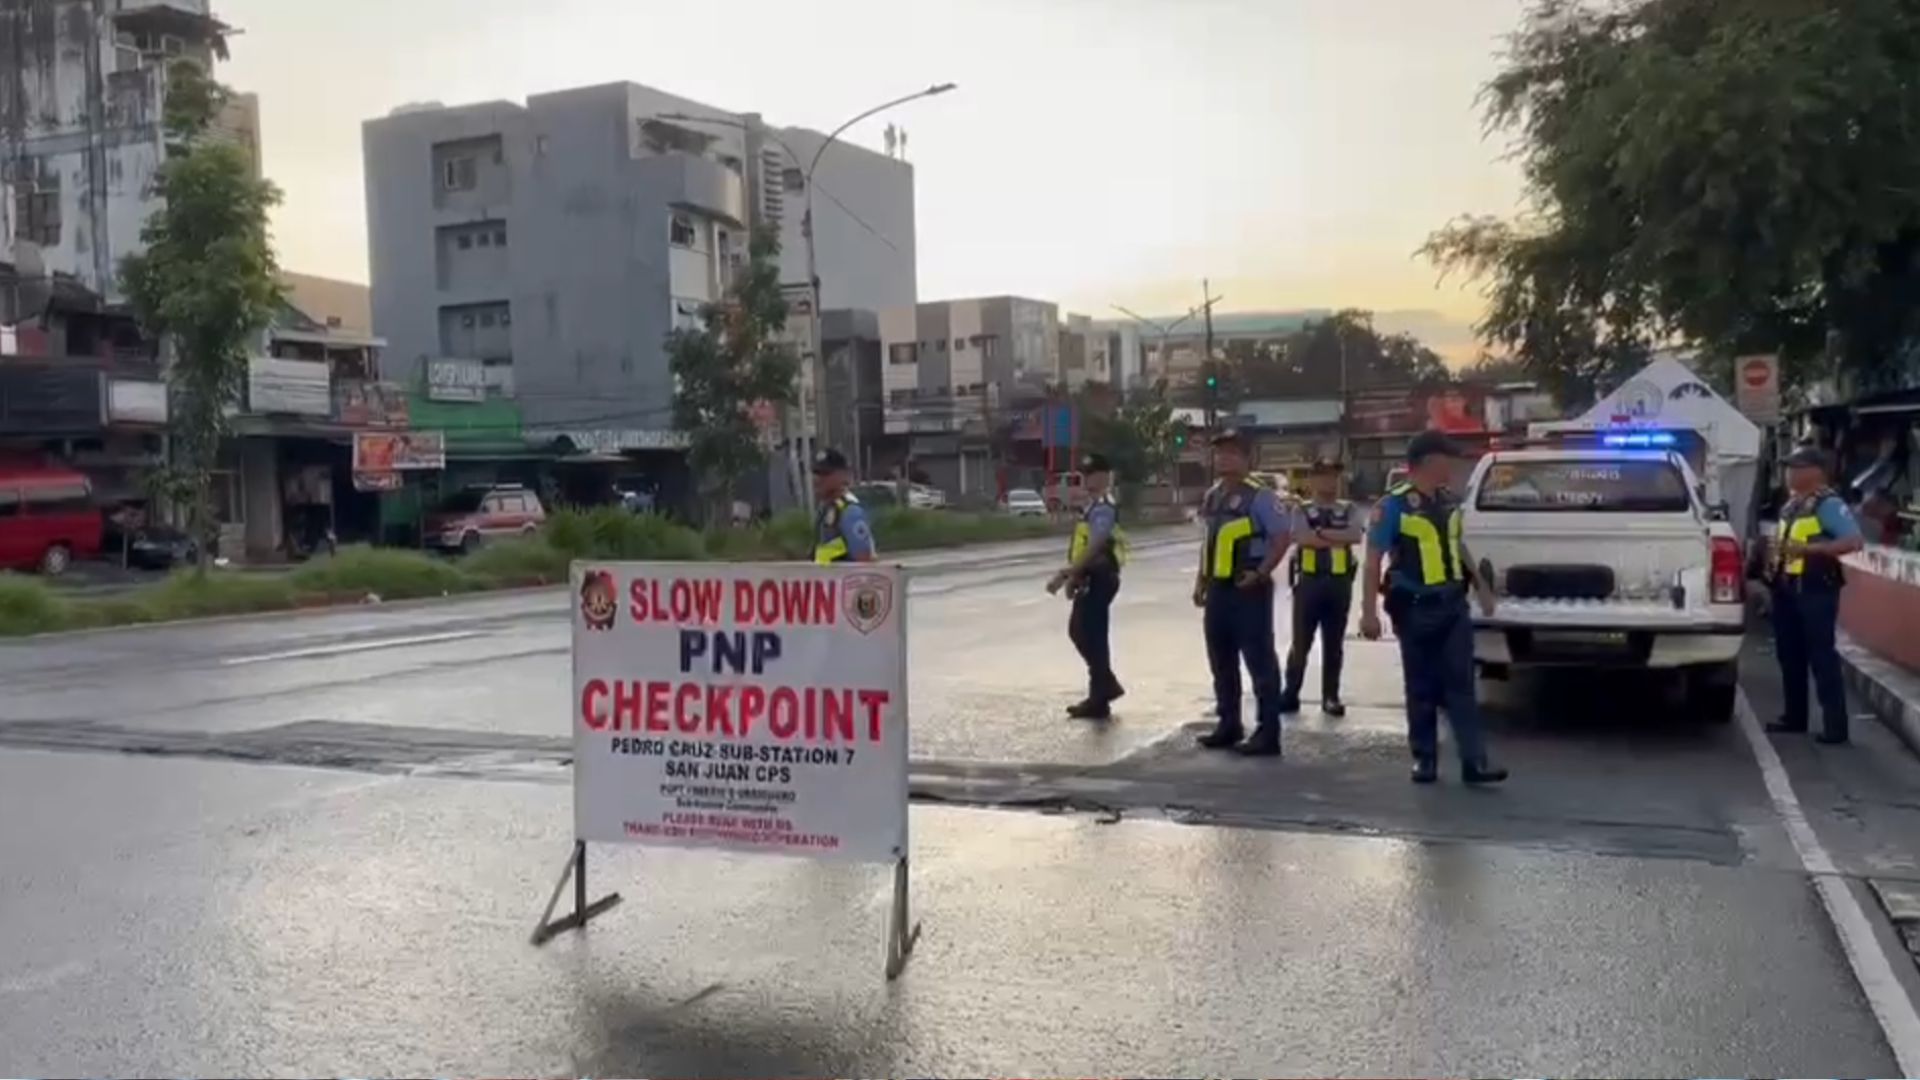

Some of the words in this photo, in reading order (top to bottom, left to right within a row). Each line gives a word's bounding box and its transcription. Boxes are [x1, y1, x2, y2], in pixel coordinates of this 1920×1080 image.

[629, 578, 723, 624] SLOW
[733, 580, 837, 626] DOWN
[679, 629, 782, 675] PNP
[581, 678, 890, 742] CHECKPOINT
[611, 737, 665, 756] PEDRO
[668, 740, 714, 759] CRUZ
[719, 744, 838, 765] SUB-STATION
[846, 749, 856, 766] 7
[665, 760, 699, 778] SAN
[702, 763, 749, 782] JUAN
[755, 765, 792, 784] CPS
